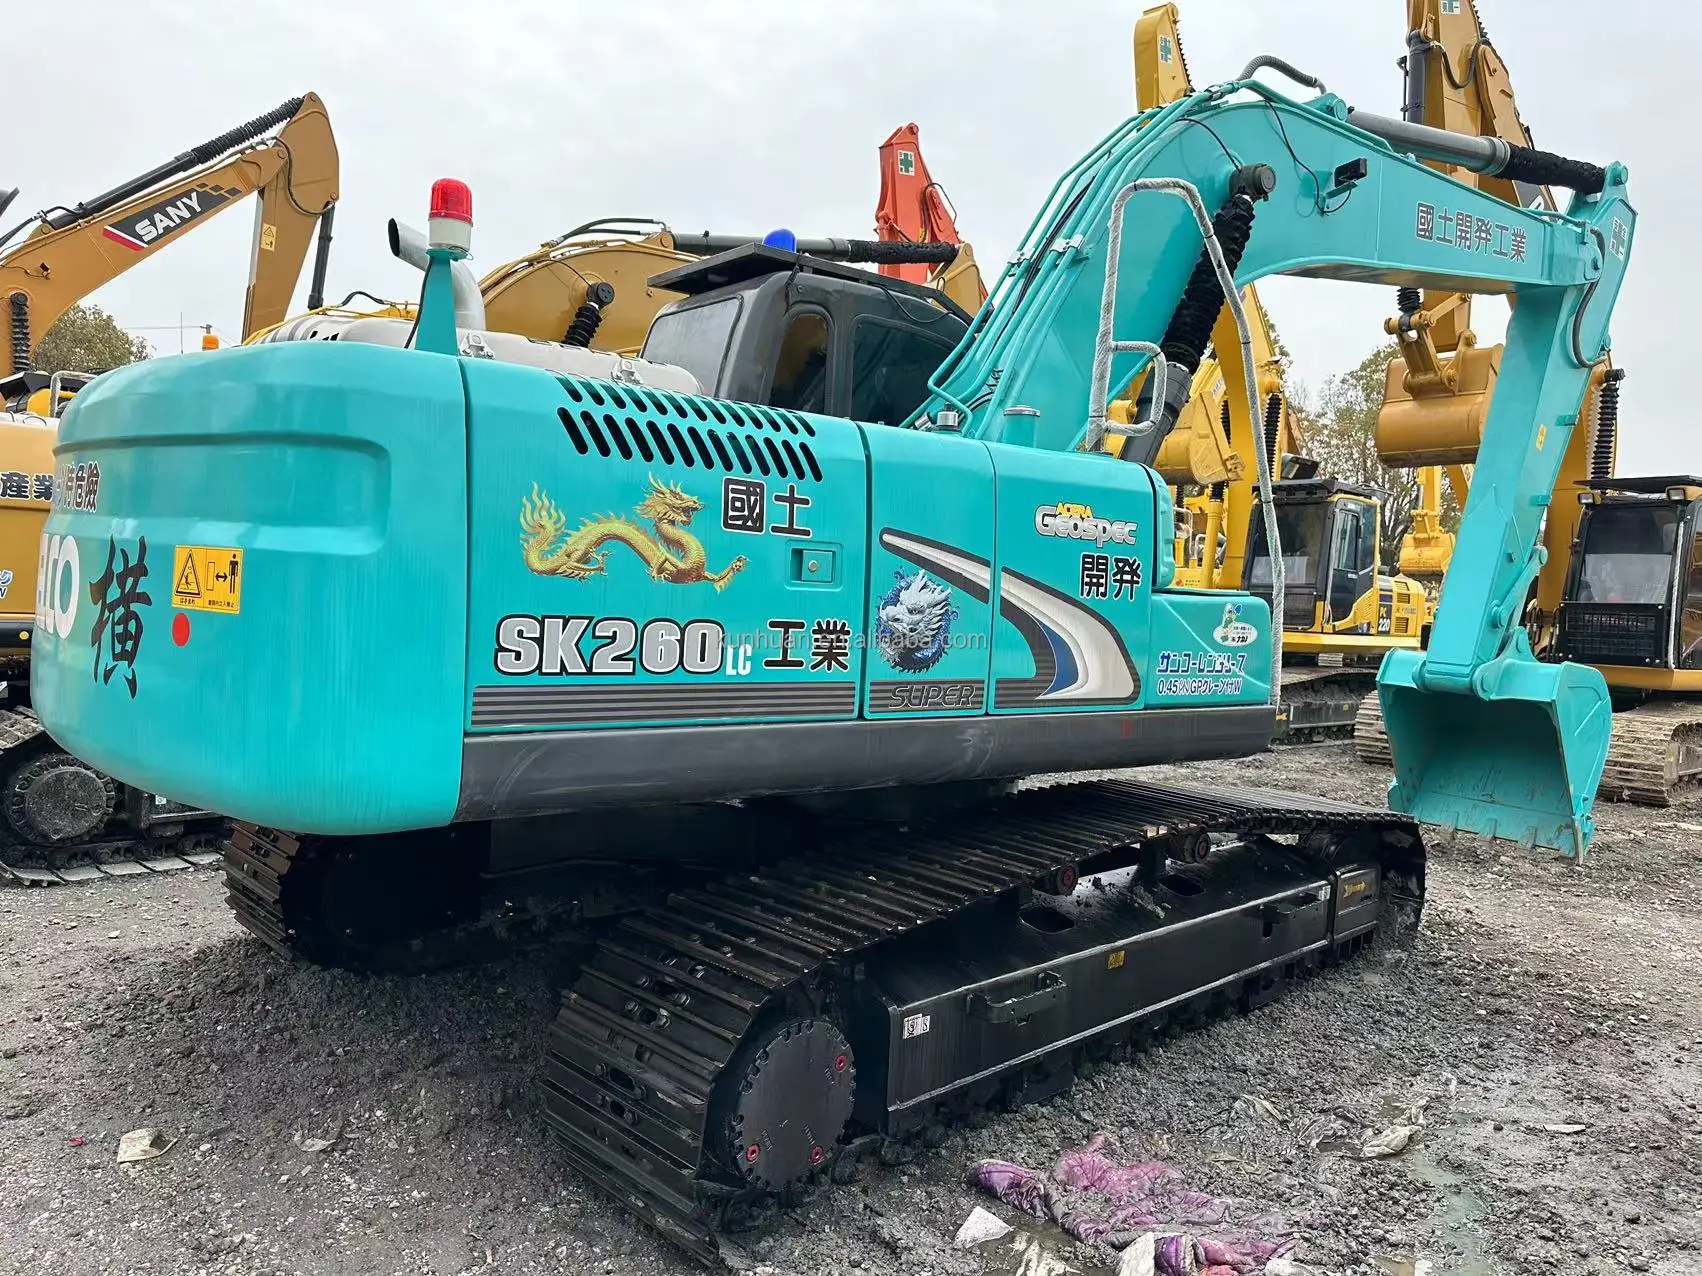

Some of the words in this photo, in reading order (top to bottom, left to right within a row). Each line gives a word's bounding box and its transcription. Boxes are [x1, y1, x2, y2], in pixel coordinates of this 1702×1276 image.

[135, 191, 202, 242] SANY
[495, 614, 726, 676] SK260
[725, 643, 752, 676] LC
[763, 618, 852, 673] 工業
[888, 684, 976, 709] SUPER
